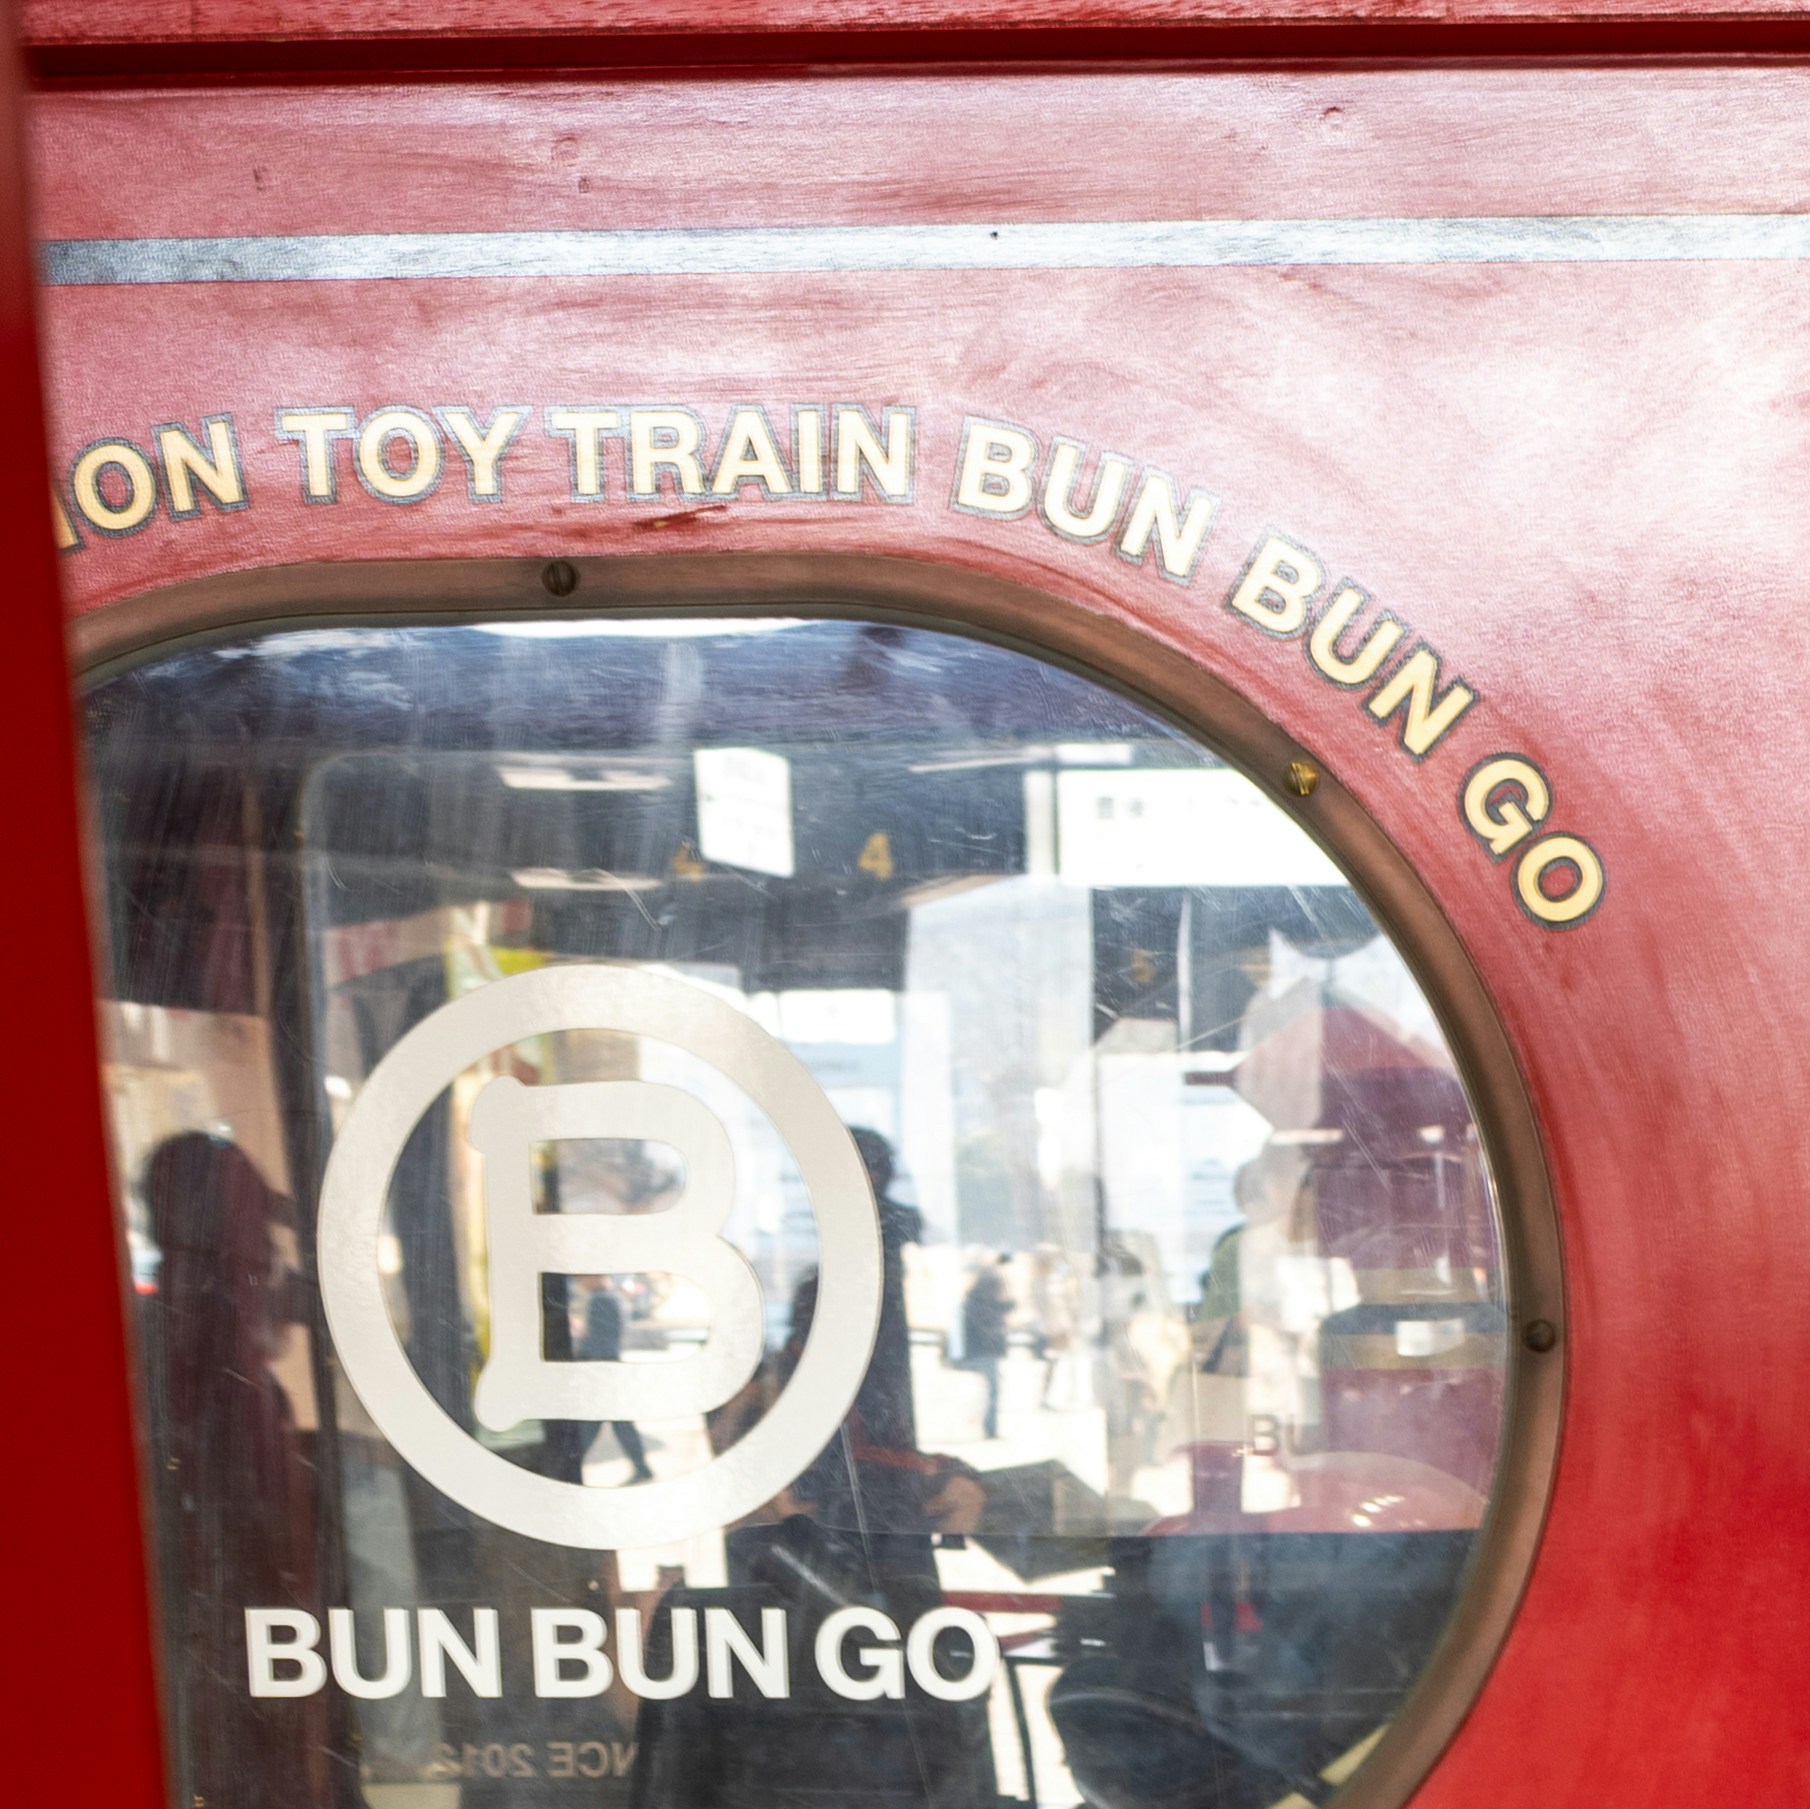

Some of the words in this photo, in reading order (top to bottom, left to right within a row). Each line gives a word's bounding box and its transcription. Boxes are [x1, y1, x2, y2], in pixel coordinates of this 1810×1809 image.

[276, 405, 531, 503] TOY
[545, 404, 918, 503] TRAIN
[950, 415, 1219, 587] BUN
[1223, 529, 1481, 765] BUN
[1457, 751, 1606, 932] GO
[245, 1607, 499, 1700] BUN
[534, 1607, 790, 1701] BUN
[814, 1606, 1001, 1702] GO
